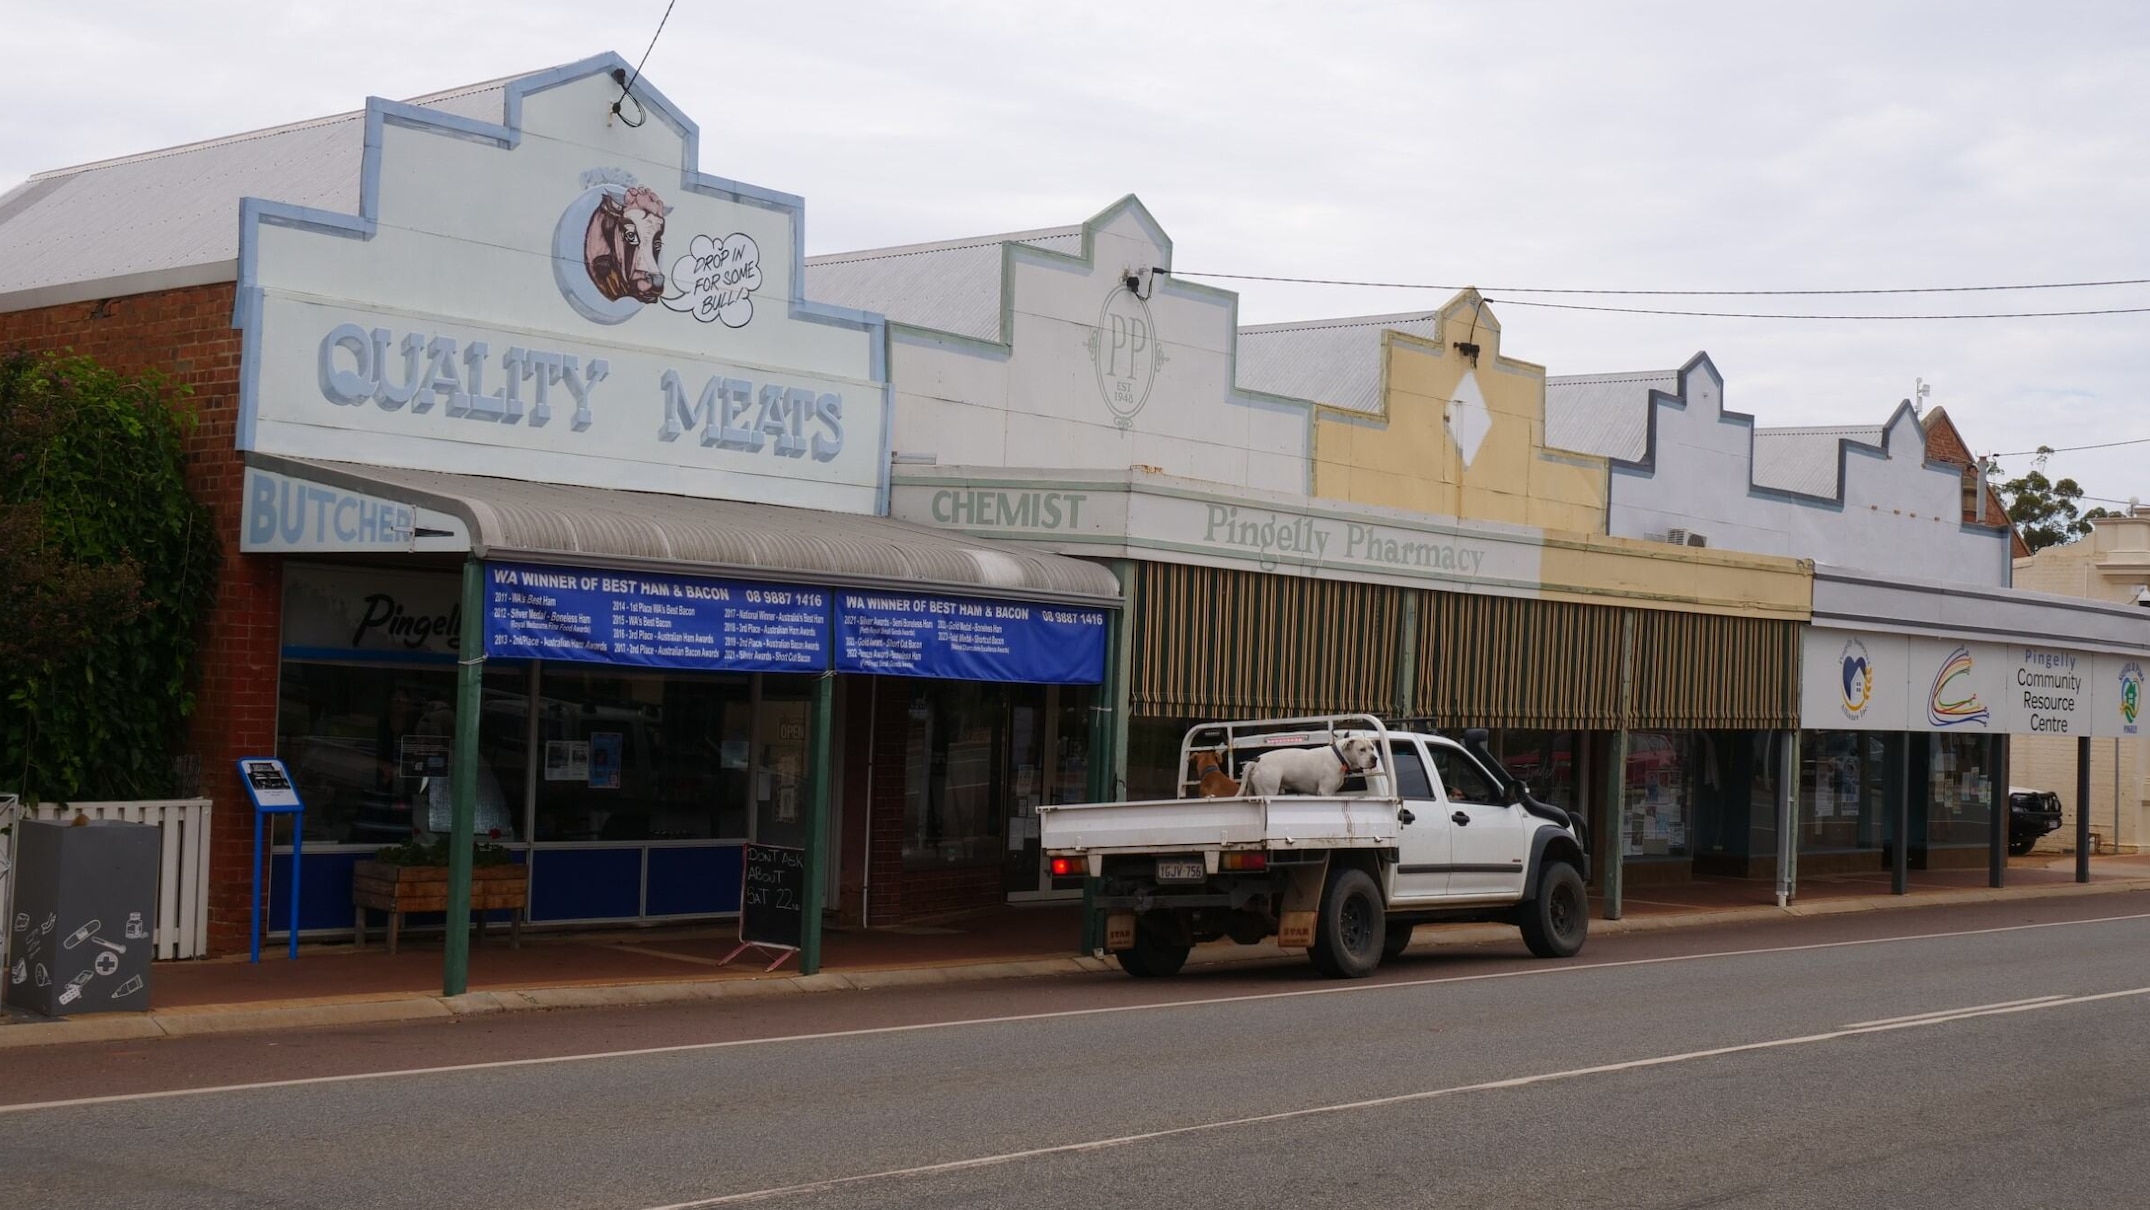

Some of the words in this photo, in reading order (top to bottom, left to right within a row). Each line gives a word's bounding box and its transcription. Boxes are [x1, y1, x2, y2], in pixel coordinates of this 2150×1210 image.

[693, 249, 730, 274] DROP
[732, 244, 746, 262] IN
[694, 273, 721, 295] FOR
[723, 261, 755, 285] SOME
[1105, 313, 1147, 380] PP
[317, 322, 611, 432] QUALITY
[658, 369, 844, 462] MEATS
[1116, 381, 1132, 392] EST
[249, 474, 412, 545] BUTCHER
[930, 490, 1087, 529] CHEMIST
[1203, 503, 1331, 576] Pingelly
[1343, 522, 1486, 591] Pharmacy
[494, 569, 518, 584] WA
[522, 572, 577, 589] WINNER
[581, 577, 598, 591] OF
[602, 578, 637, 594] BEST
[640, 582, 669, 596] HAM
[673, 585, 682, 597] &
[685, 586, 730, 601] BACON
[495, 592, 507, 602] 2011
[527, 594, 542, 605] Best
[543, 596, 556, 606] Ham
[746, 590, 761, 603] 08
[763, 591, 792, 605] 9887
[795, 593, 822, 607] 1416
[511, 608, 528, 619] Silver
[551, 611, 577, 623] Boneless
[578, 614, 591, 624] Ham
[612, 601, 625, 611] 2014
[630, 603, 638, 612] 1st
[639, 603, 652, 613] Place
[666, 605, 678, 614] Best
[679, 606, 695, 616] Bacon
[846, 596, 865, 609] WA
[867, 597, 910, 611] WINNER
[913, 599, 927, 612] OF
[930, 601, 957, 615] BEST
[959, 604, 982, 617] HAM
[985, 606, 993, 617] &
[995, 606, 1029, 620] BACON
[352, 594, 462, 649] Pingell
[612, 615, 624, 625] 2015
[629, 616, 642, 626] WA's
[643, 616, 655, 627] Best
[656, 618, 672, 628] Bacon
[814, 614, 824, 624] Ham
[923, 619, 934, 628] Ham
[1041, 610, 1054, 622] 08
[1055, 611, 1078, 624] 9887
[1080, 613, 1103, 625] 1416
[629, 630, 638, 639] 3rd
[639, 630, 653, 640] Place
[657, 631, 682, 642] Australian
[683, 632, 694, 643] Ham
[695, 633, 714, 644] Awards
[764, 625, 788, 635] Australian
[640, 644, 654, 654] Place
[657, 645, 684, 656] Australian
[684, 647, 701, 657] Bacon
[701, 648, 719, 658] Awards
[754, 651, 772, 661] Awards
[2025, 649, 2076, 671] Pingelly
[2017, 668, 2082, 695] Community
[2024, 691, 2075, 711] Resource
[780, 724, 804, 739] OPEN
[2030, 713, 2068, 733] Centre
[748, 866, 785, 884] ABOUT
[747, 886, 769, 905] SAT
